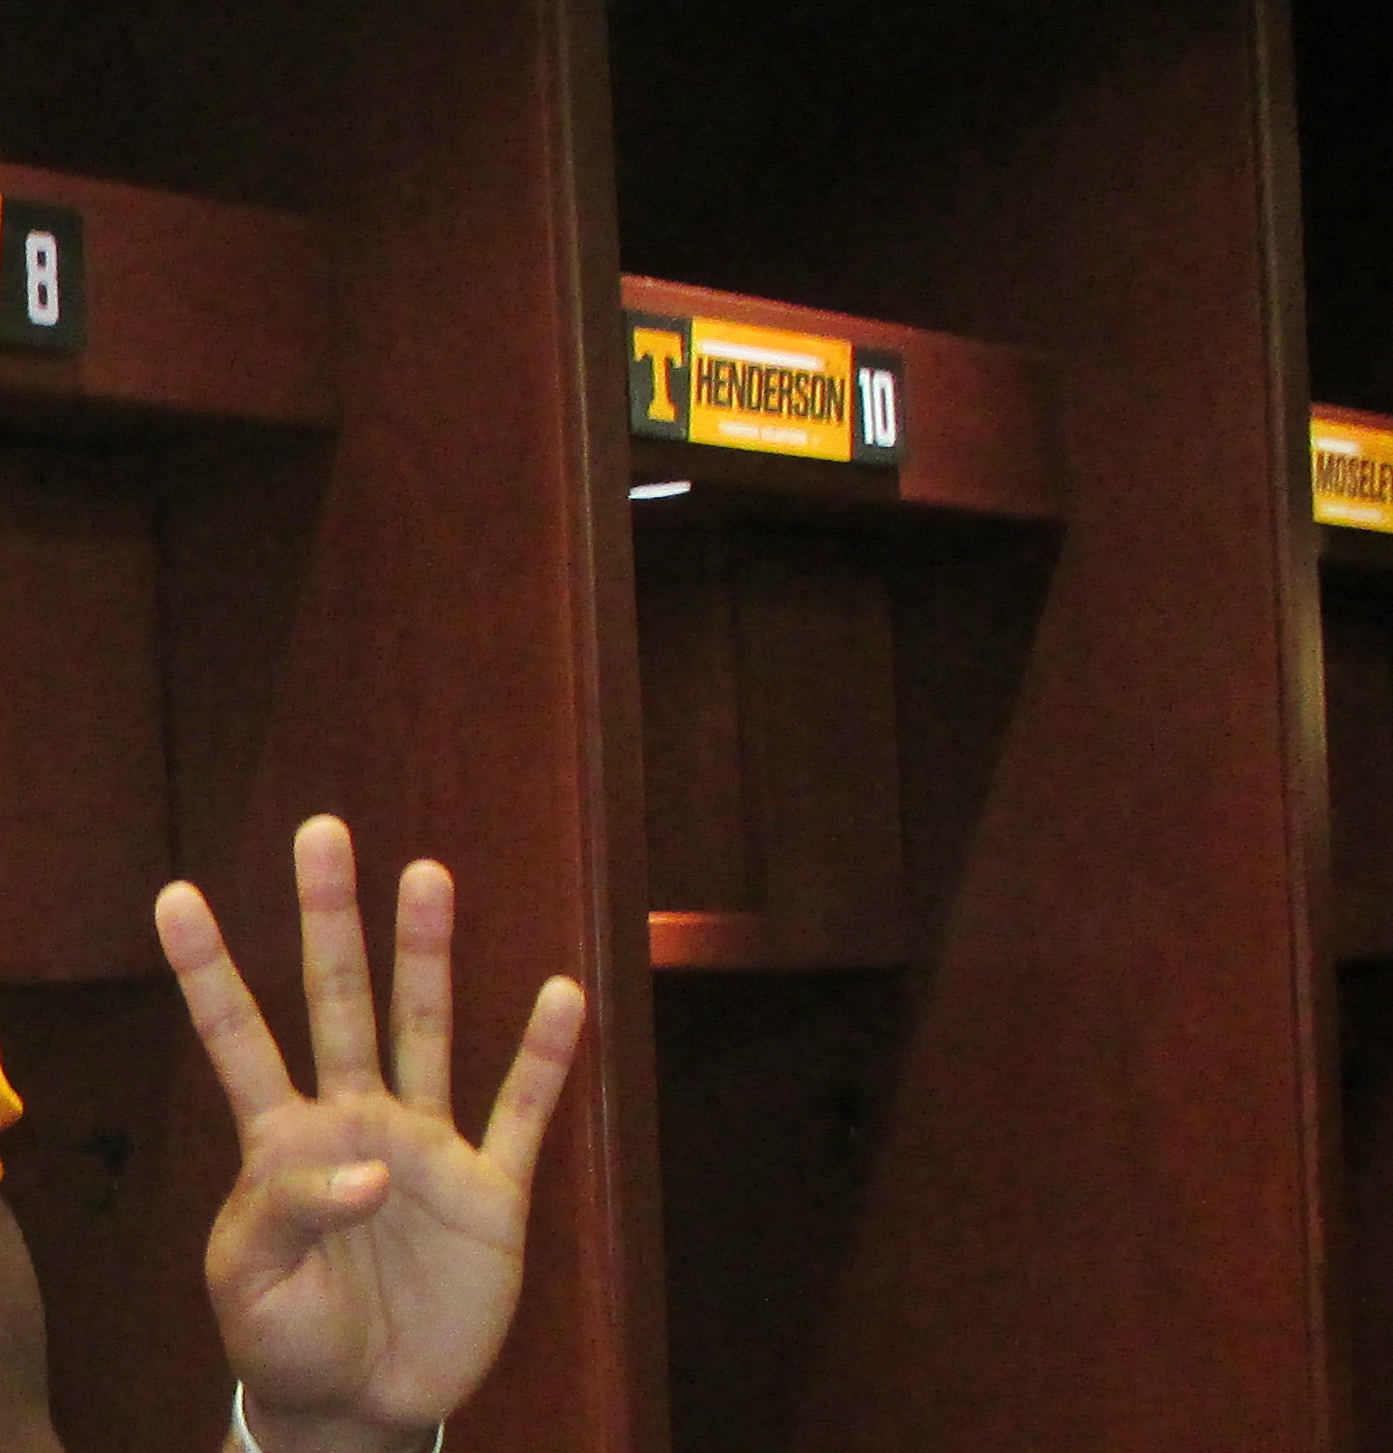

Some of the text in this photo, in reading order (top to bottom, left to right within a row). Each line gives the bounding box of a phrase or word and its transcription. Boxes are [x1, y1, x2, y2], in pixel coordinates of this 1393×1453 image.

[25, 229, 59, 326] 8
[633, 327, 684, 422] T
[696, 357, 846, 424] HENDERSON
[857, 367, 897, 448] 10
